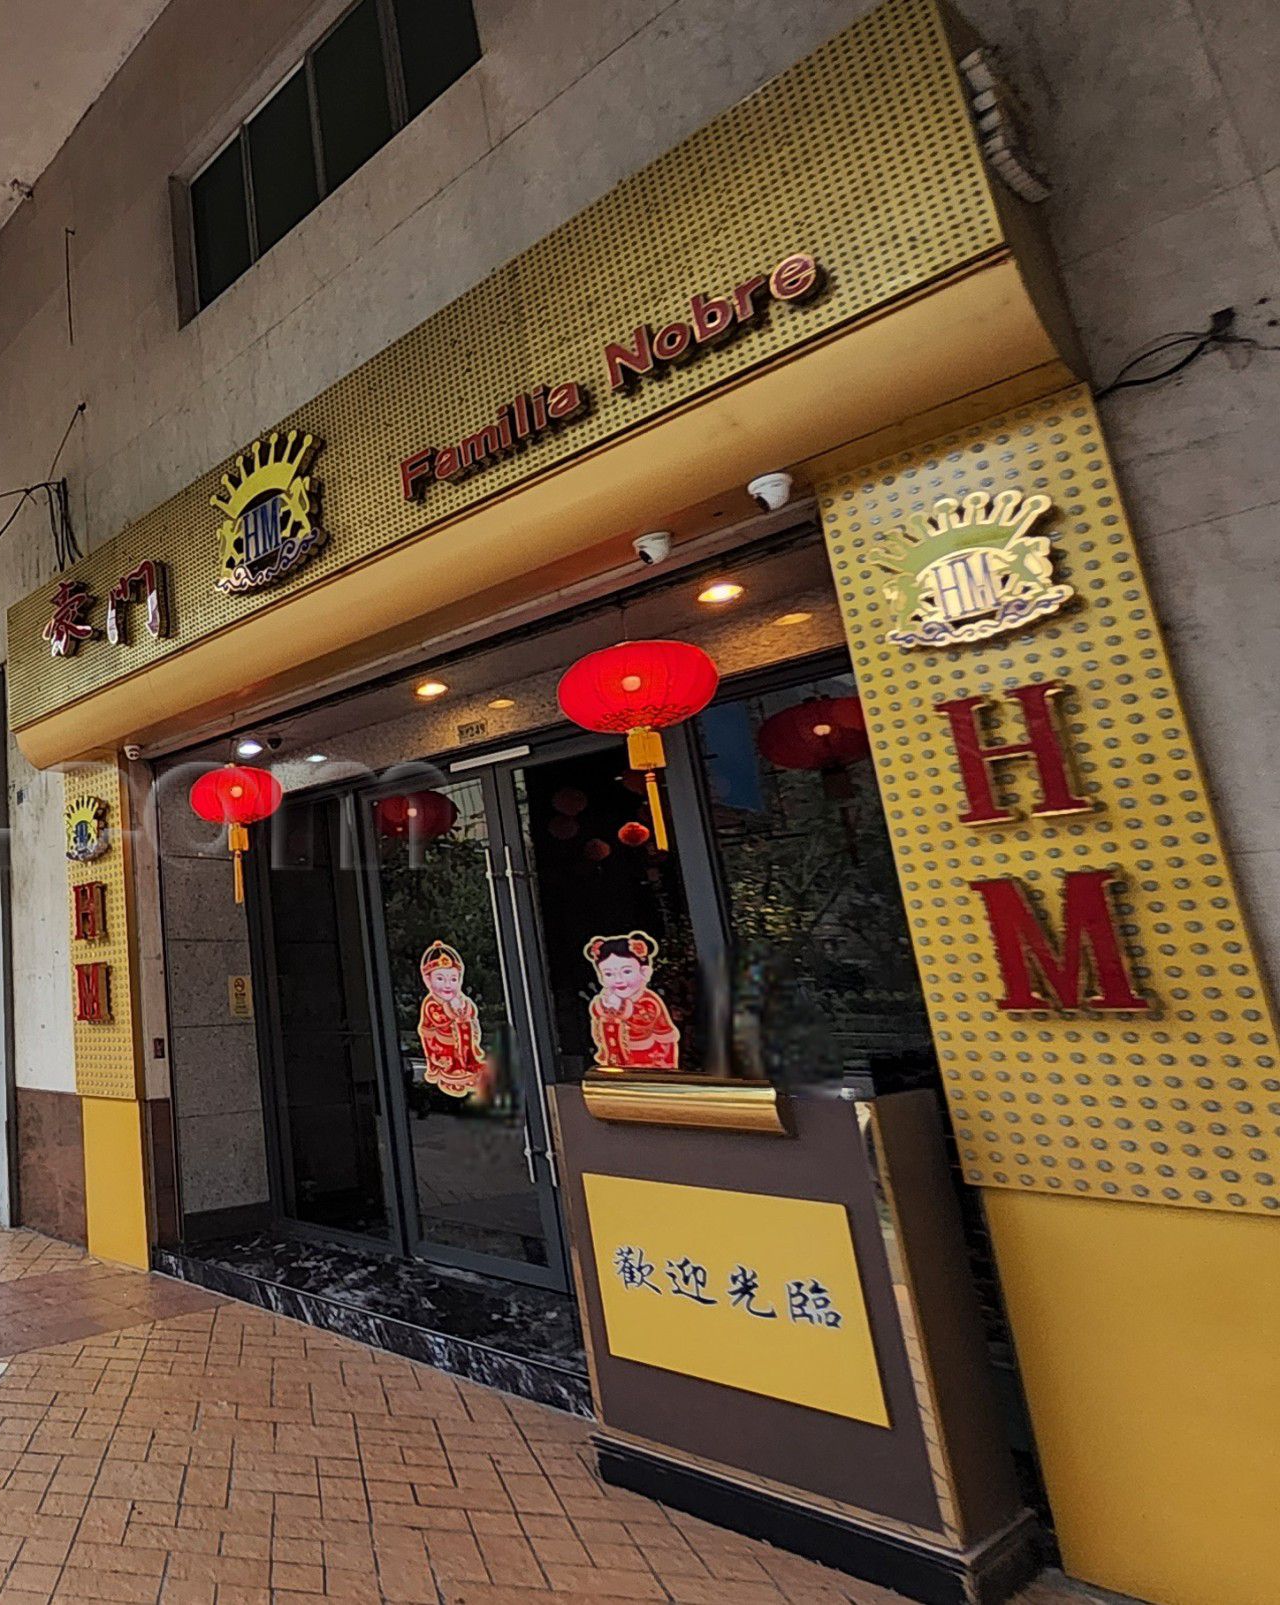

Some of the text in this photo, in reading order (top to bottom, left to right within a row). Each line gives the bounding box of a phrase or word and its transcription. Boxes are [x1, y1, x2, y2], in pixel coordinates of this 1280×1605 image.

[400, 253, 816, 500] Familia Nobre
[243, 497, 283, 562] HM
[931, 551, 1002, 620] HM
[615, 1246, 844, 1329] 歡迎光臨
